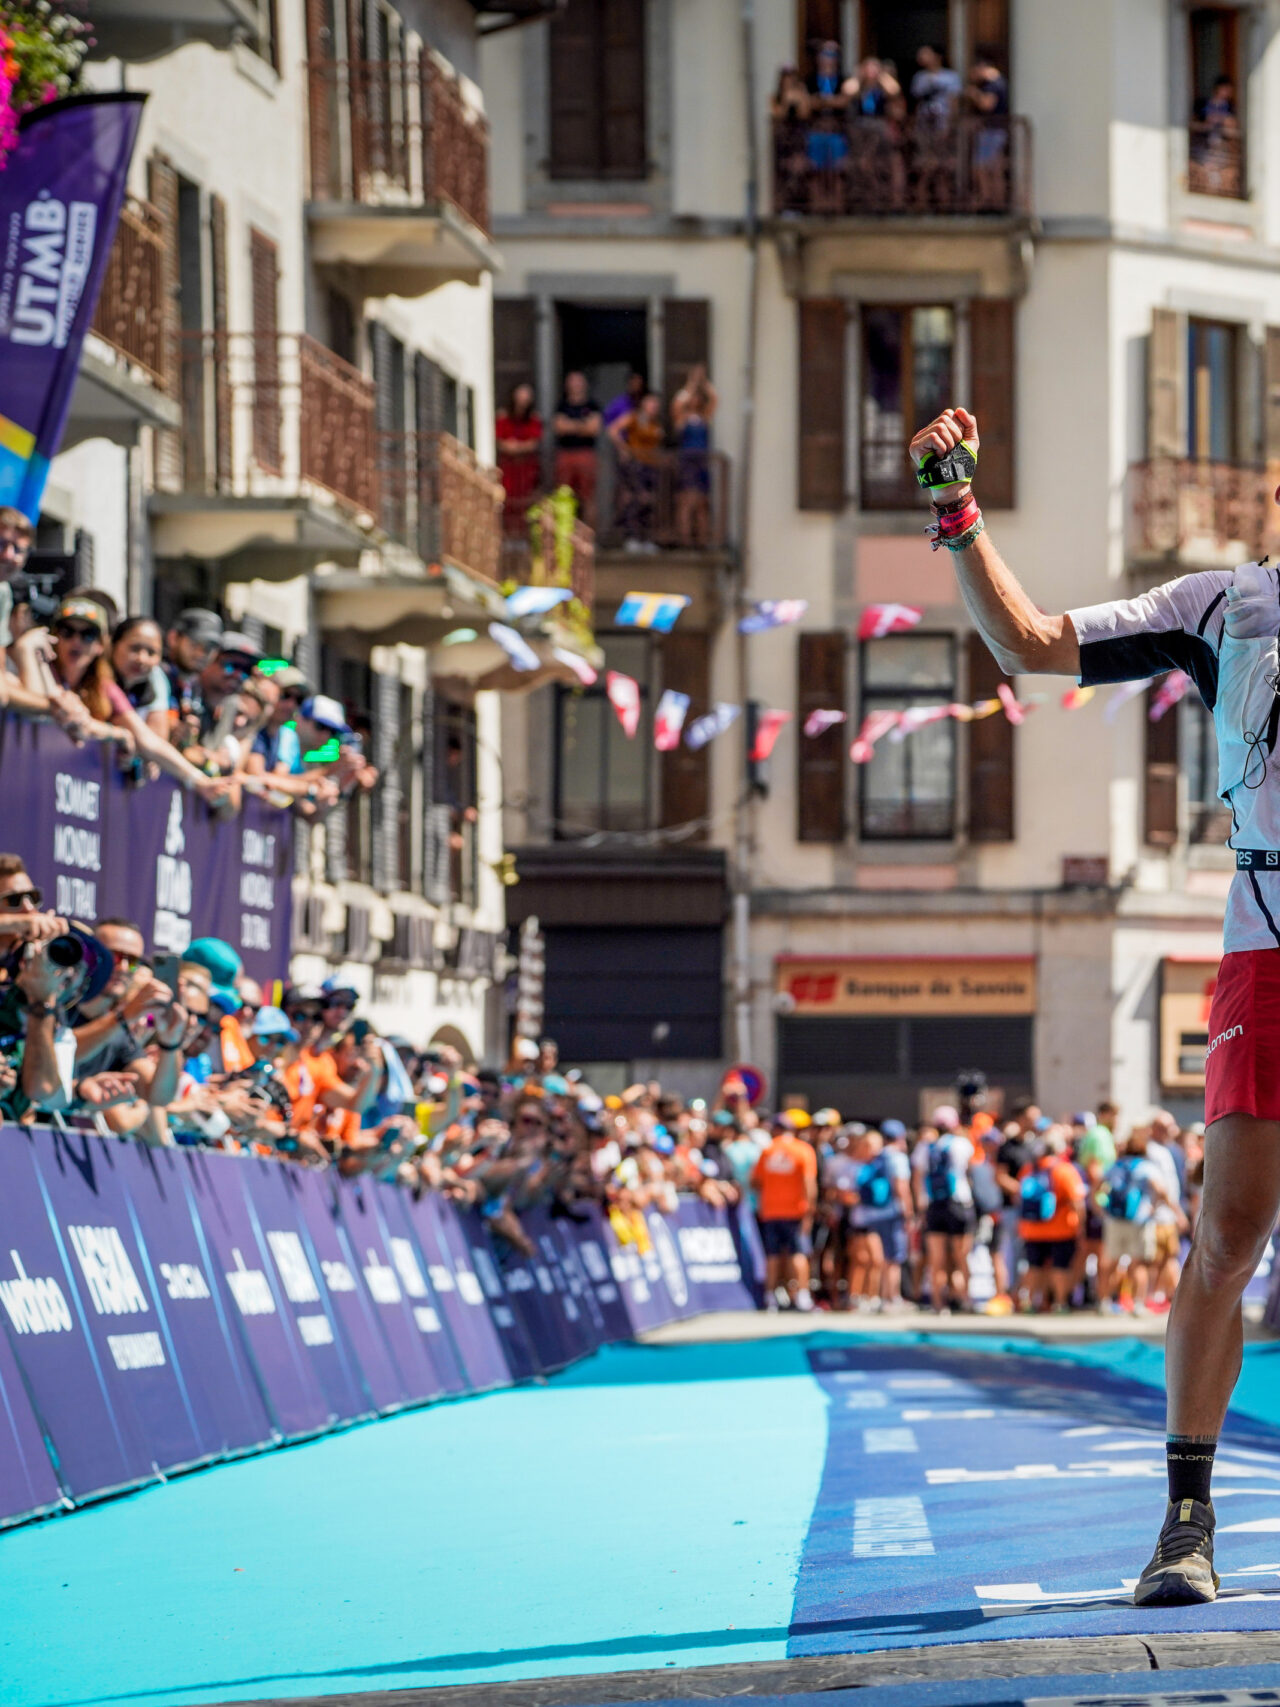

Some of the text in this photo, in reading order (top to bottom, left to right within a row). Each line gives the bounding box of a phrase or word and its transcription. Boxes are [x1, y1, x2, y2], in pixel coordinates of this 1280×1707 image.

[10, 198, 67, 346] UTMB
[846, 977, 921, 1001] Banque
[930, 978, 951, 996] de
